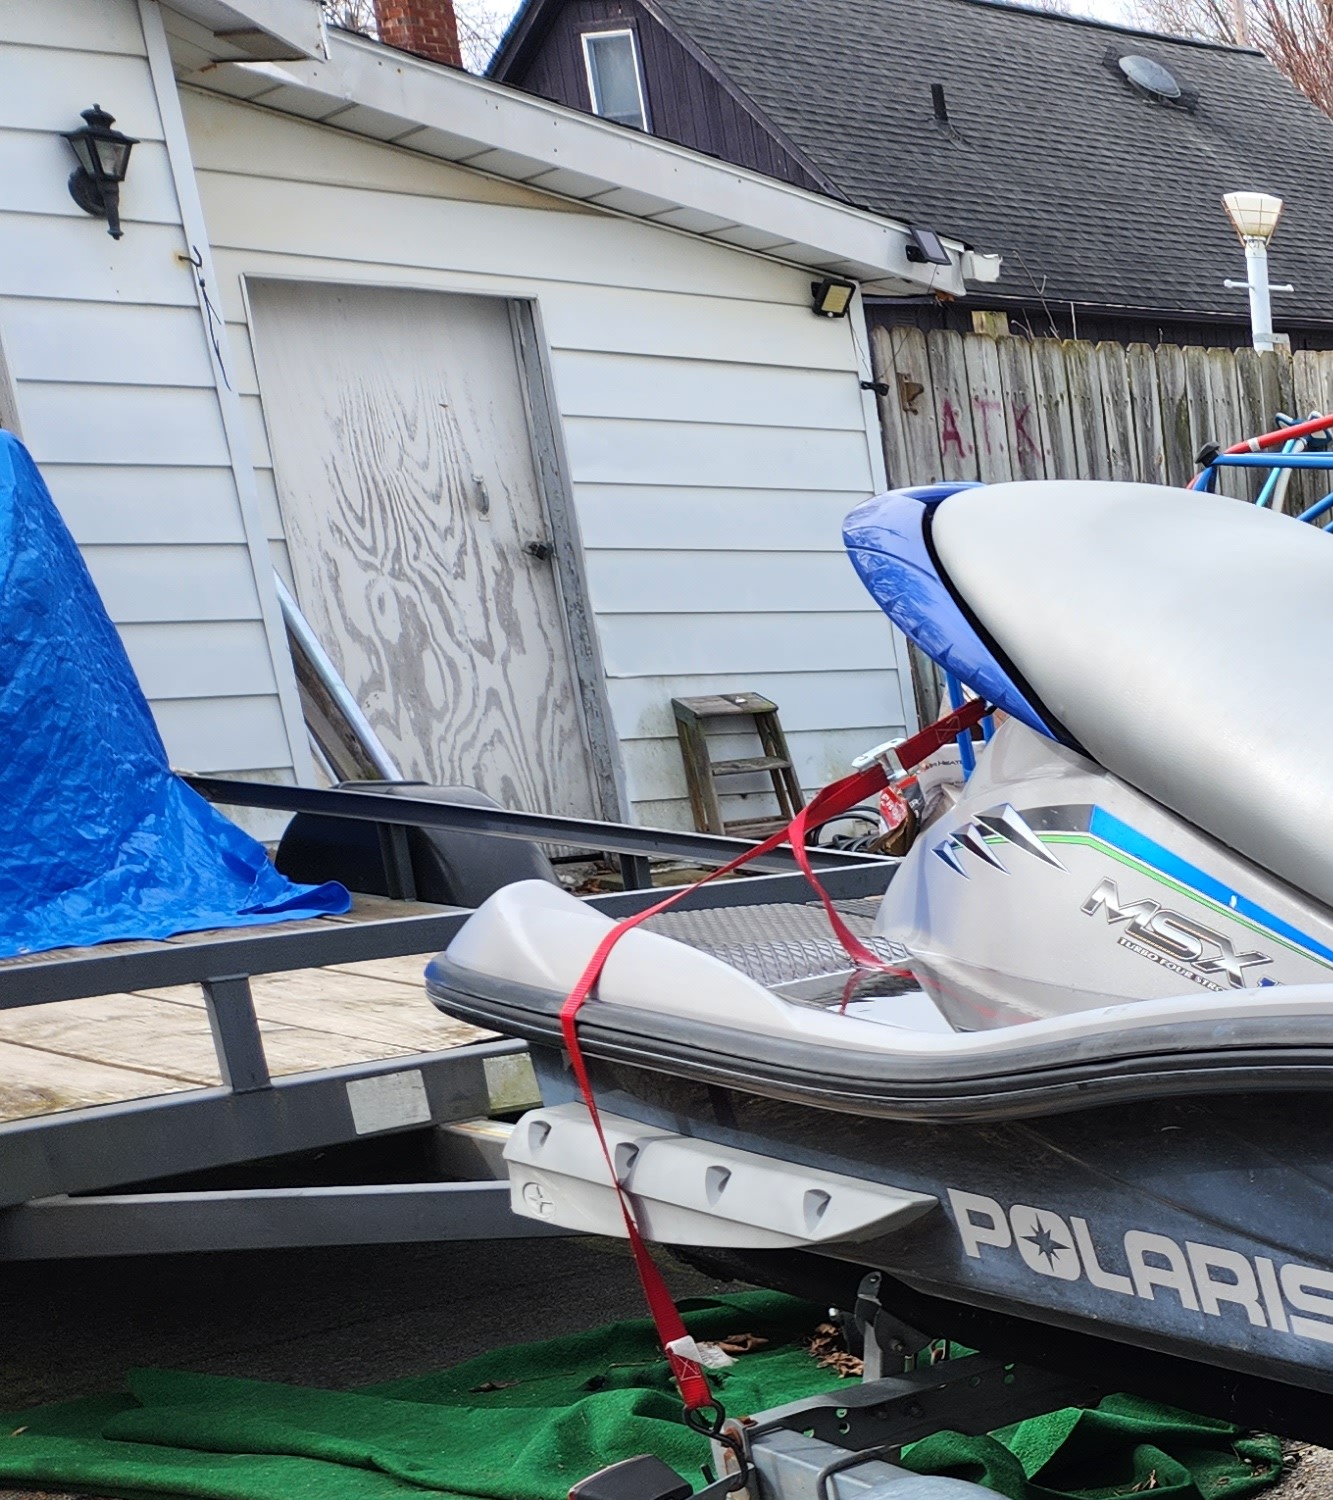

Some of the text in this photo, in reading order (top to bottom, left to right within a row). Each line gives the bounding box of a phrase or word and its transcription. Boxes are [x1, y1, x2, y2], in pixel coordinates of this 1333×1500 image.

[1080, 875, 1274, 989] MSX
[1118, 937, 1159, 963] TURBO
[1159, 958, 1195, 980] FOUR
